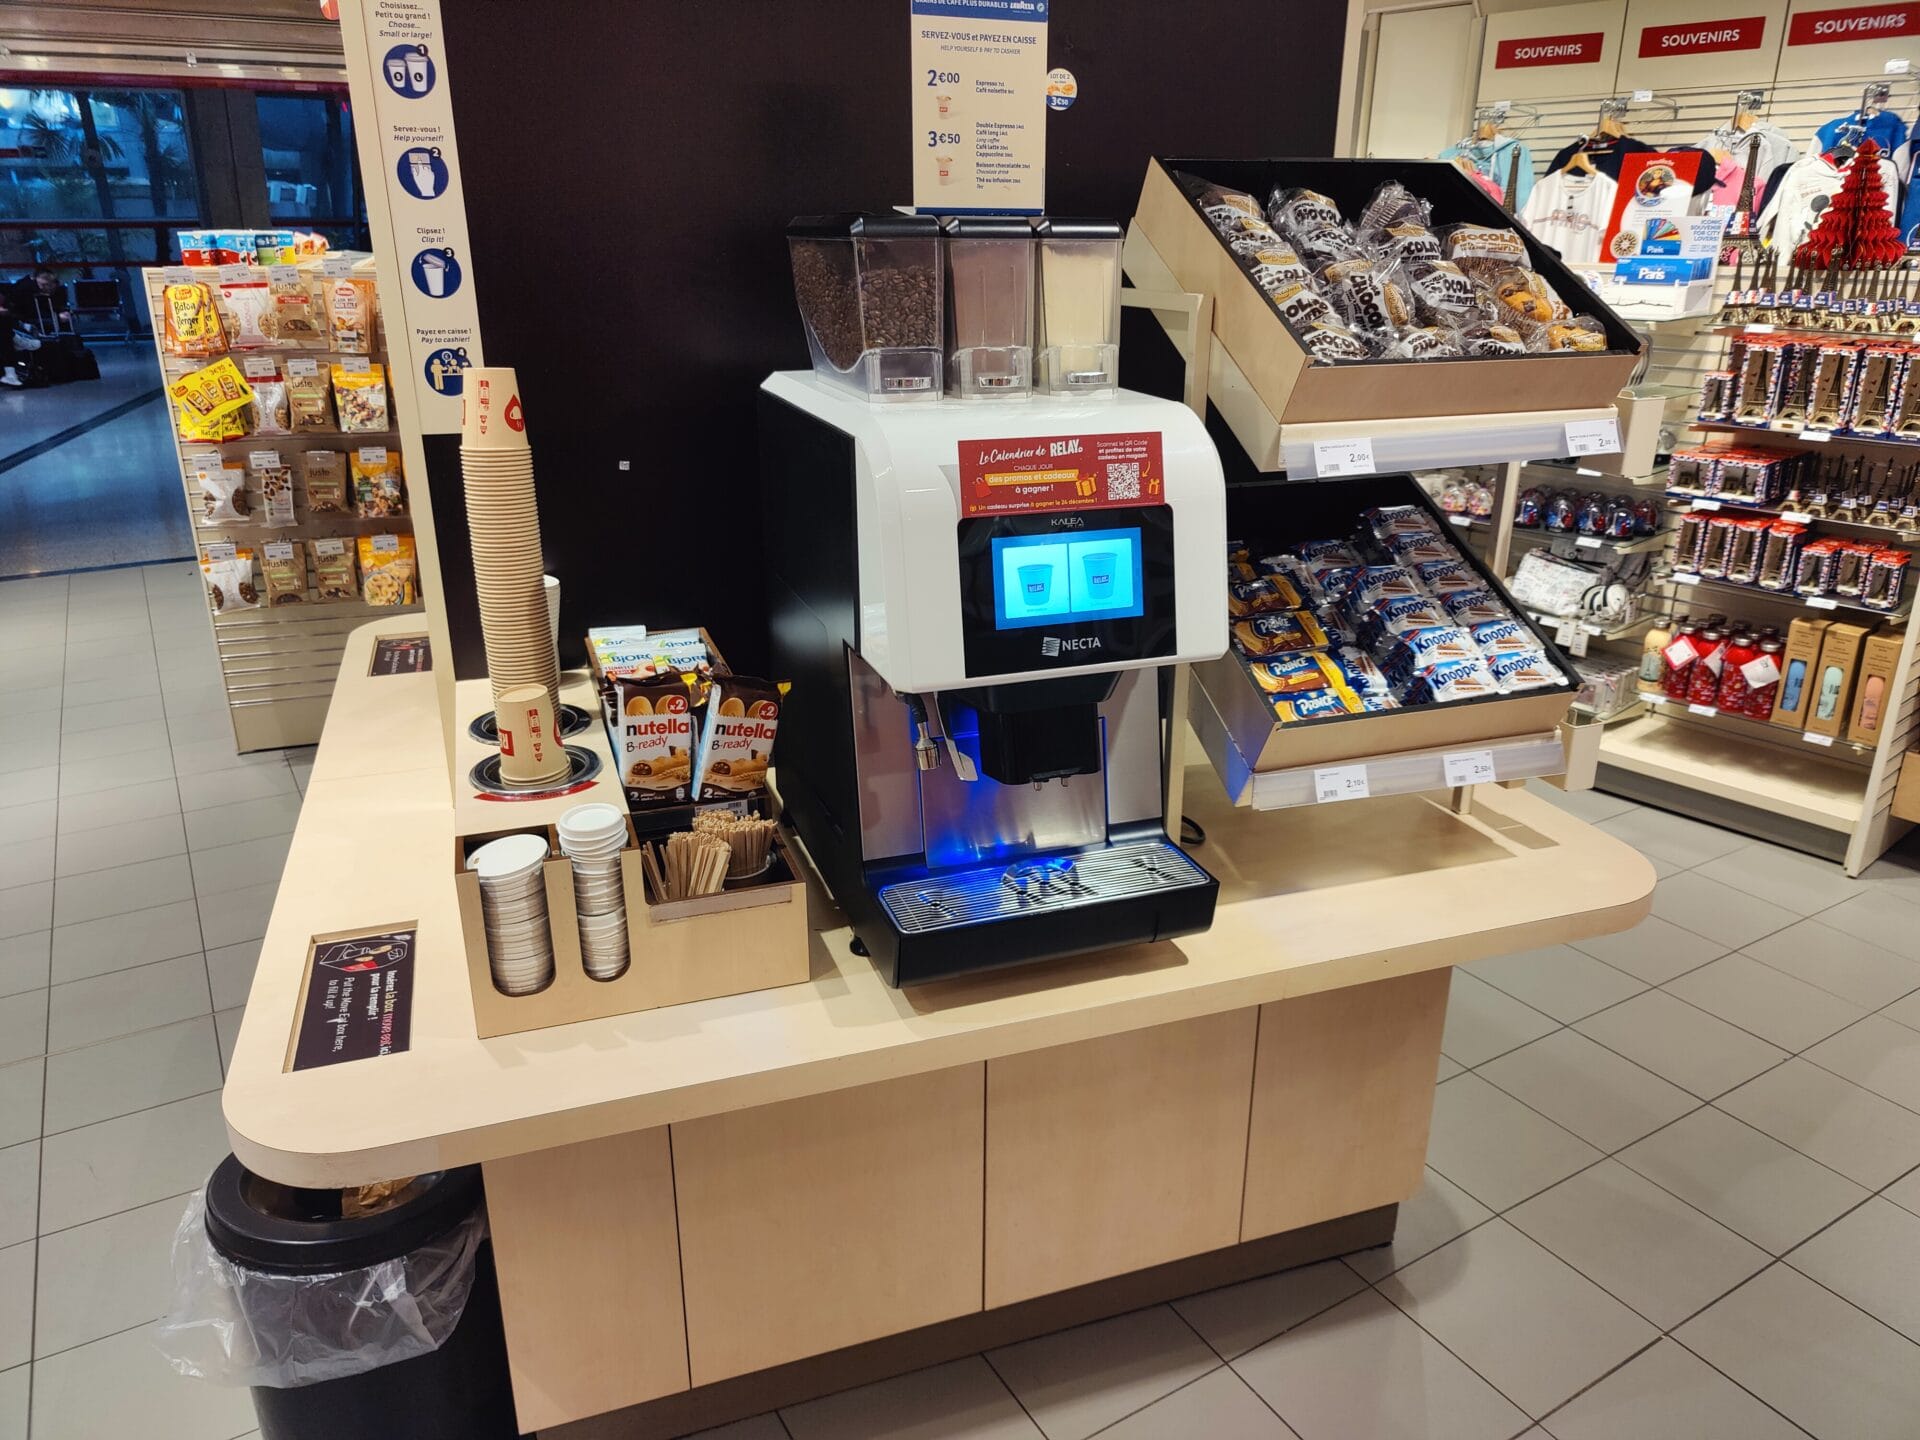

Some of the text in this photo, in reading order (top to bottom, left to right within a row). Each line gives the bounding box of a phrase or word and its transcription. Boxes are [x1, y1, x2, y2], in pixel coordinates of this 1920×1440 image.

[978, 0, 1008, 8] DURABLES
[1815, 13, 1906, 35] SOUVENIRS
[411, 31, 432, 39] large!
[922, 30, 971, 41] SERVEZ-VOUS
[980, 33, 1001, 42] PAYEZ
[1003, 35, 1012, 43] EN
[1013, 36, 1036, 44] CAISSE
[1661, 29, 1740, 48] SOUVENIRS
[1514, 44, 1583, 60] SOUVENIRS
[928, 70, 960, 86] 2€00
[393, 125, 436, 133] Servez-vous
[394, 134, 411, 142] Help
[928, 130, 960, 147] 3€50
[416, 228, 441, 236] Clipsez
[1638, 268, 1666, 280] Paris
[416, 328, 435, 336] Payez
[979, 451, 989, 465] Le
[990, 448, 1033, 463] Calendrier
[1035, 445, 1046, 456] de
[989, 471, 1075, 484] des promos et cadeaux
[1022, 485, 1049, 494] gagner
[1051, 517, 1084, 526] KALEA
[1062, 637, 1101, 651] NECTA
[1415, 630, 1463, 654] Knoppe
[1492, 655, 1542, 681] Knoppe
[669, 699, 684, 711] x2
[760, 705, 776, 717] x2
[626, 718, 690, 737] nutella
[715, 722, 776, 740] nutella
[626, 736, 668, 752] B-ready
[712, 738, 752, 751] B-ready
[630, 792, 639, 801] 2
[704, 788, 713, 798] 2
[344, 977, 355, 987] Put
[342, 987, 353, 997] the
[340, 997, 352, 1012] Move
